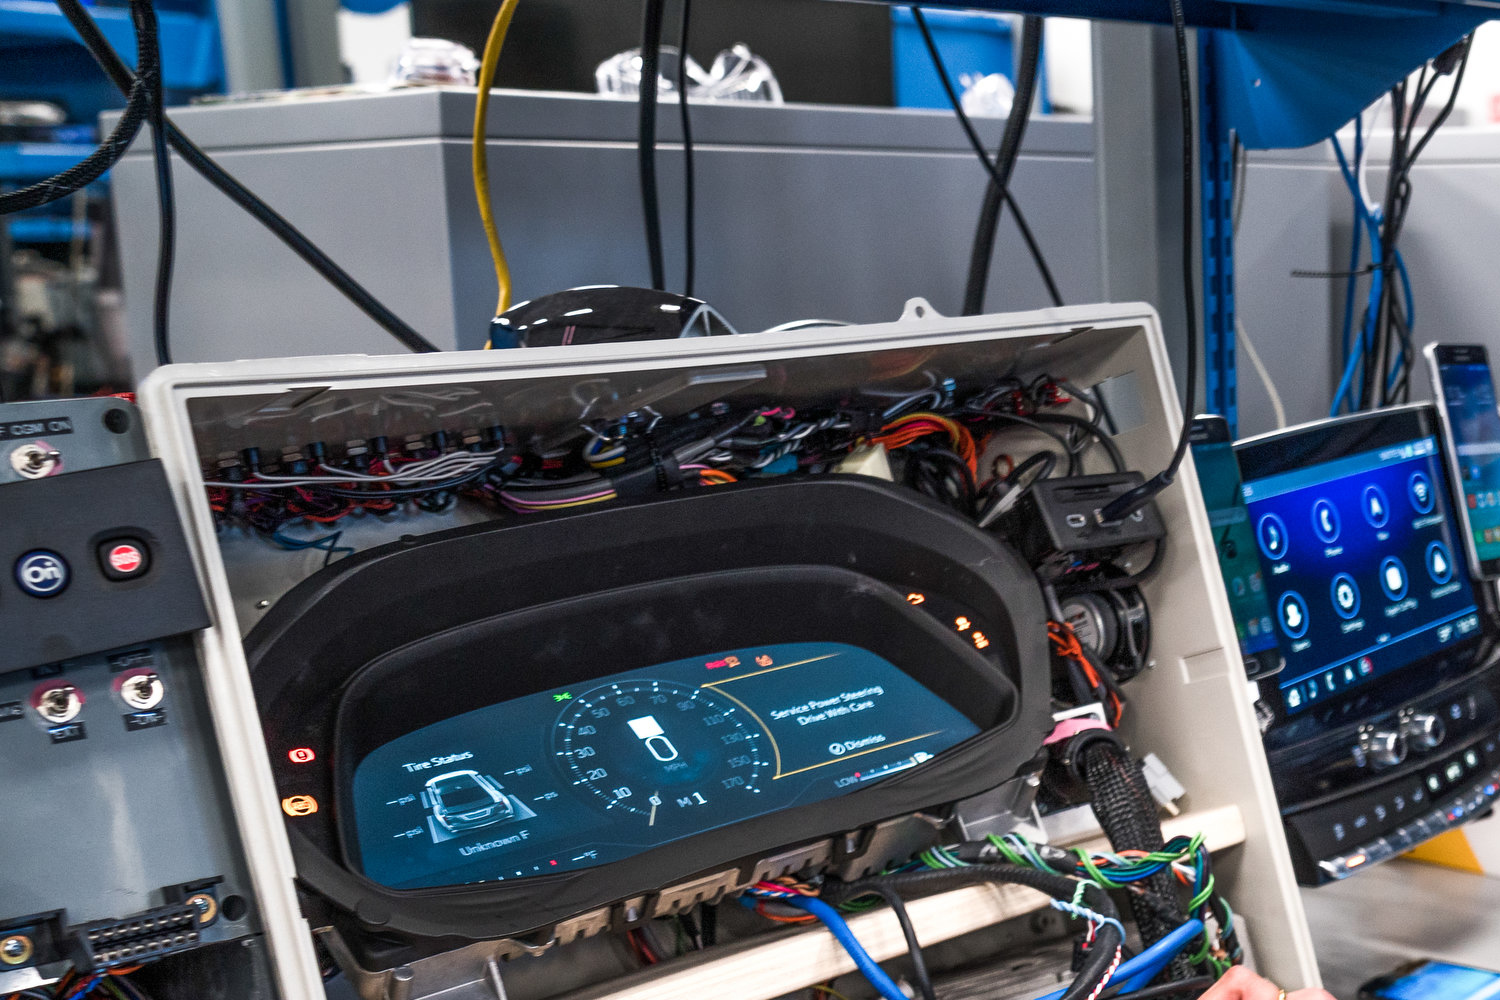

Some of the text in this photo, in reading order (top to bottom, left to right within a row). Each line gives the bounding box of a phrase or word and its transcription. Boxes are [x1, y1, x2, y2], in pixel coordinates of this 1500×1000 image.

[616, 695, 635, 707] 60
[650, 694, 668, 705] 70
[770, 685, 885, 720] Service Power Steering
[797, 700, 875, 726] Drive With Care
[703, 714, 725, 727] 110
[577, 725, 597, 736] 40
[721, 733, 744, 745] 130
[844, 734, 887, 751] Dismiss
[574, 746, 596, 759] 30
[645, 735, 679, 762] 0
[402, 751, 474, 773] Tire Status
[727, 755, 751, 769] 150
[586, 767, 608, 782] 20
[721, 776, 745, 789] 170
[612, 786, 632, 800] 10
[458, 830, 530, 856] Unknown F
